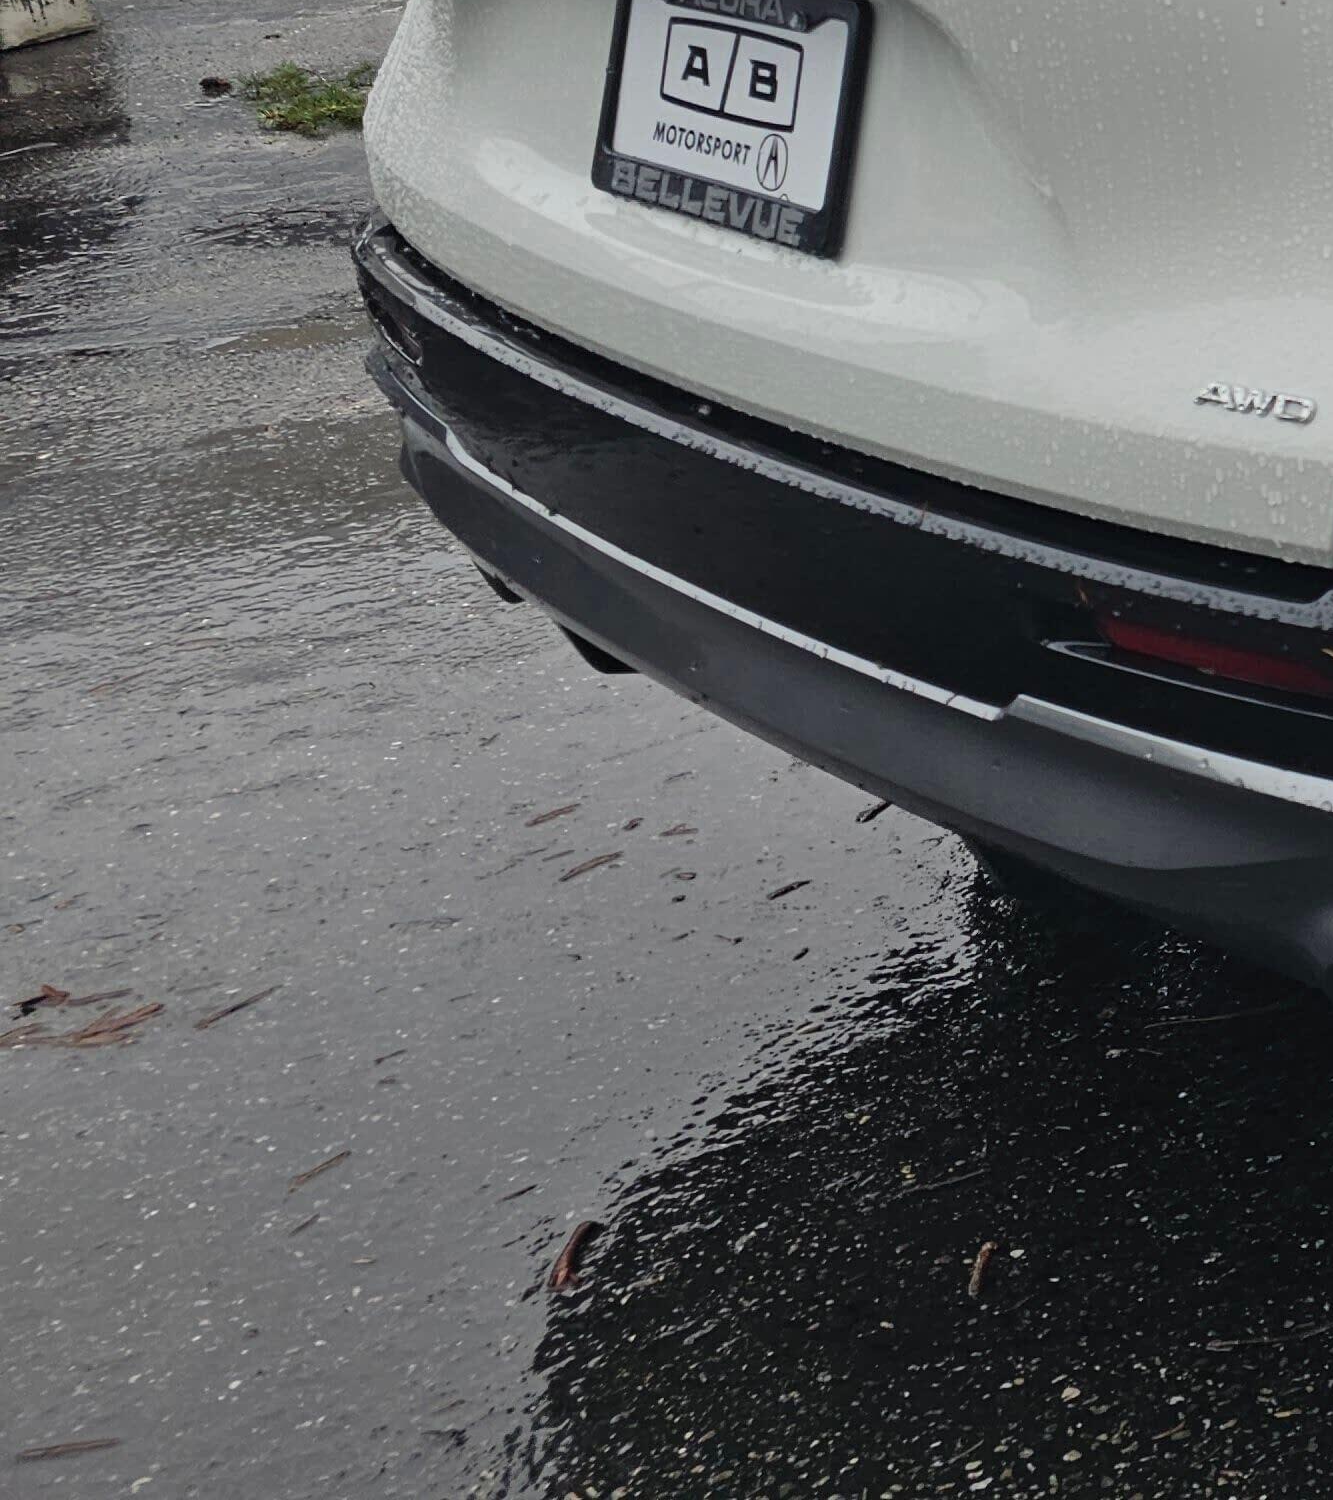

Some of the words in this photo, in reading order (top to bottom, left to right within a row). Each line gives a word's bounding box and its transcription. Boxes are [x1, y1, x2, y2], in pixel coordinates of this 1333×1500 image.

[681, 44, 710, 87] A
[748, 59, 778, 103] B
[652, 120, 752, 165] MOTORSPORT
[610, 159, 805, 247] BELLEVUE
[1192, 381, 1318, 426] AWD
